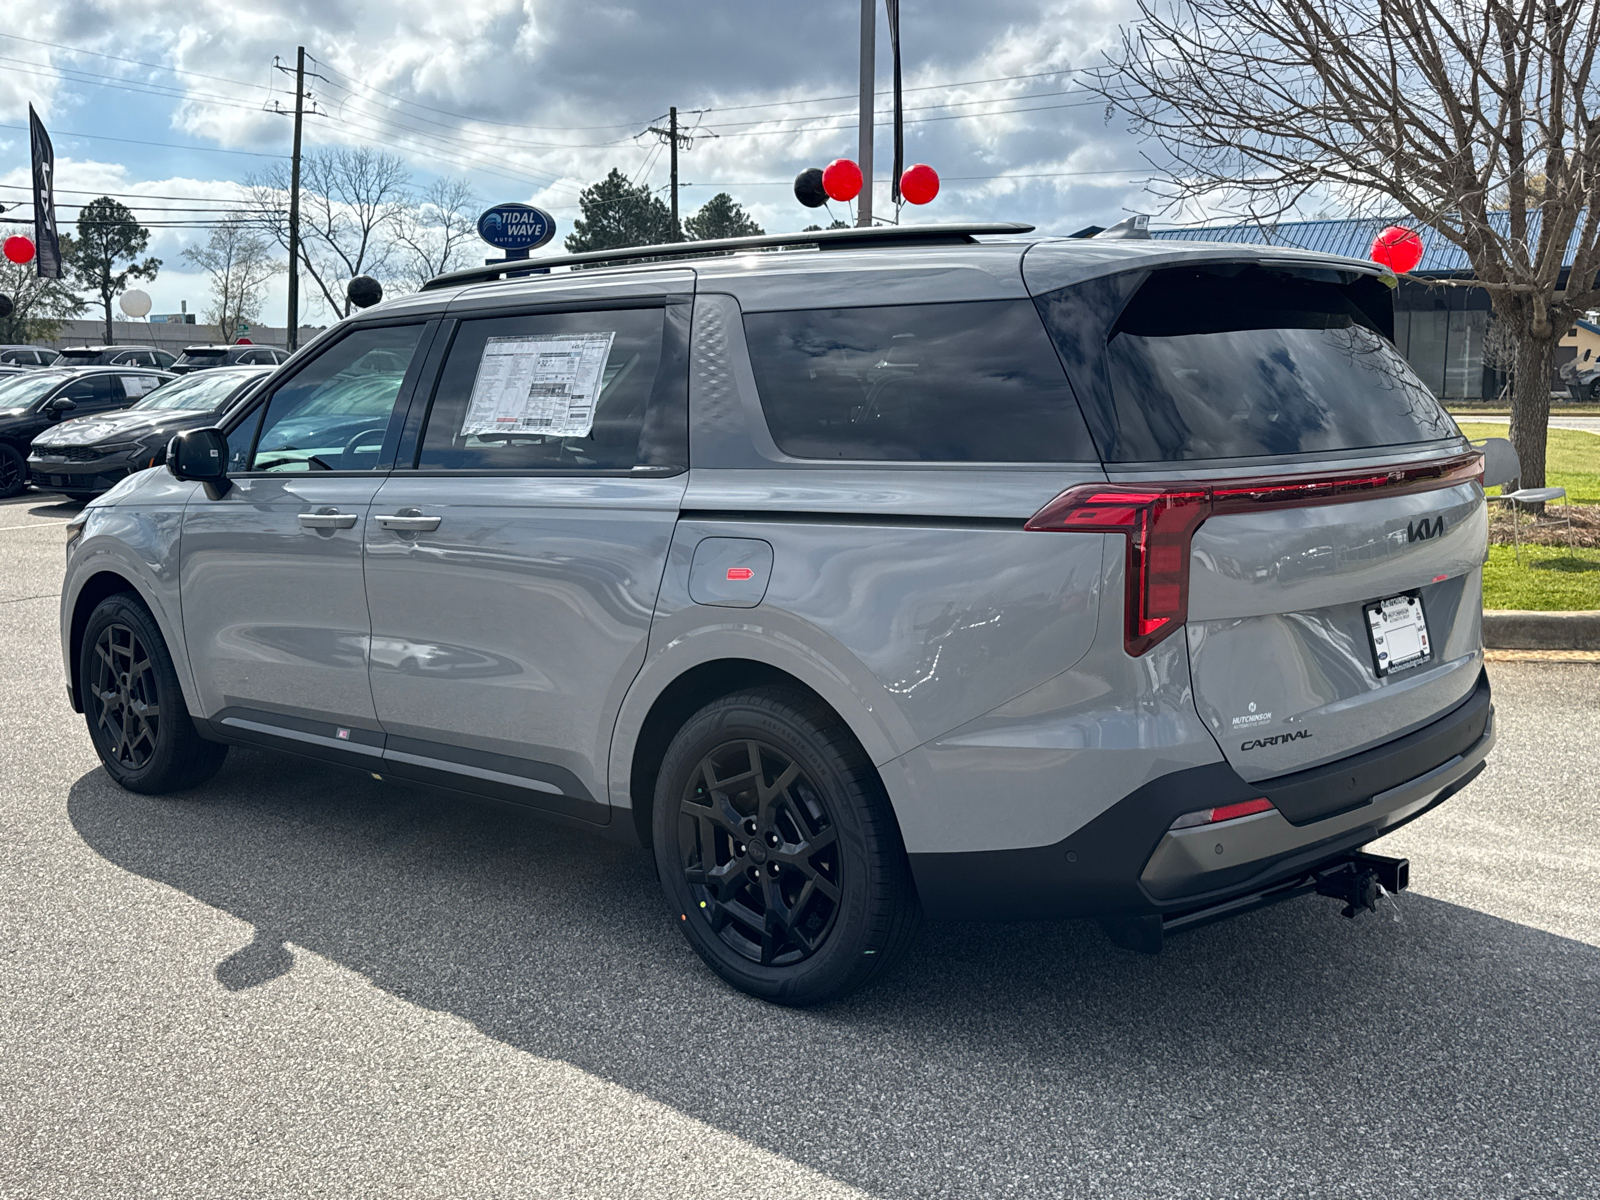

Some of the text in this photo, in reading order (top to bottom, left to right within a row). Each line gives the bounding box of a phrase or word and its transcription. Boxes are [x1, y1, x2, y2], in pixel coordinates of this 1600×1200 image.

[502, 212, 535, 224] TIDAL
[507, 224, 542, 236] WAVE
[1232, 711, 1272, 725] HUTCHINSON
[1241, 729, 1313, 752] CARNIVAL
